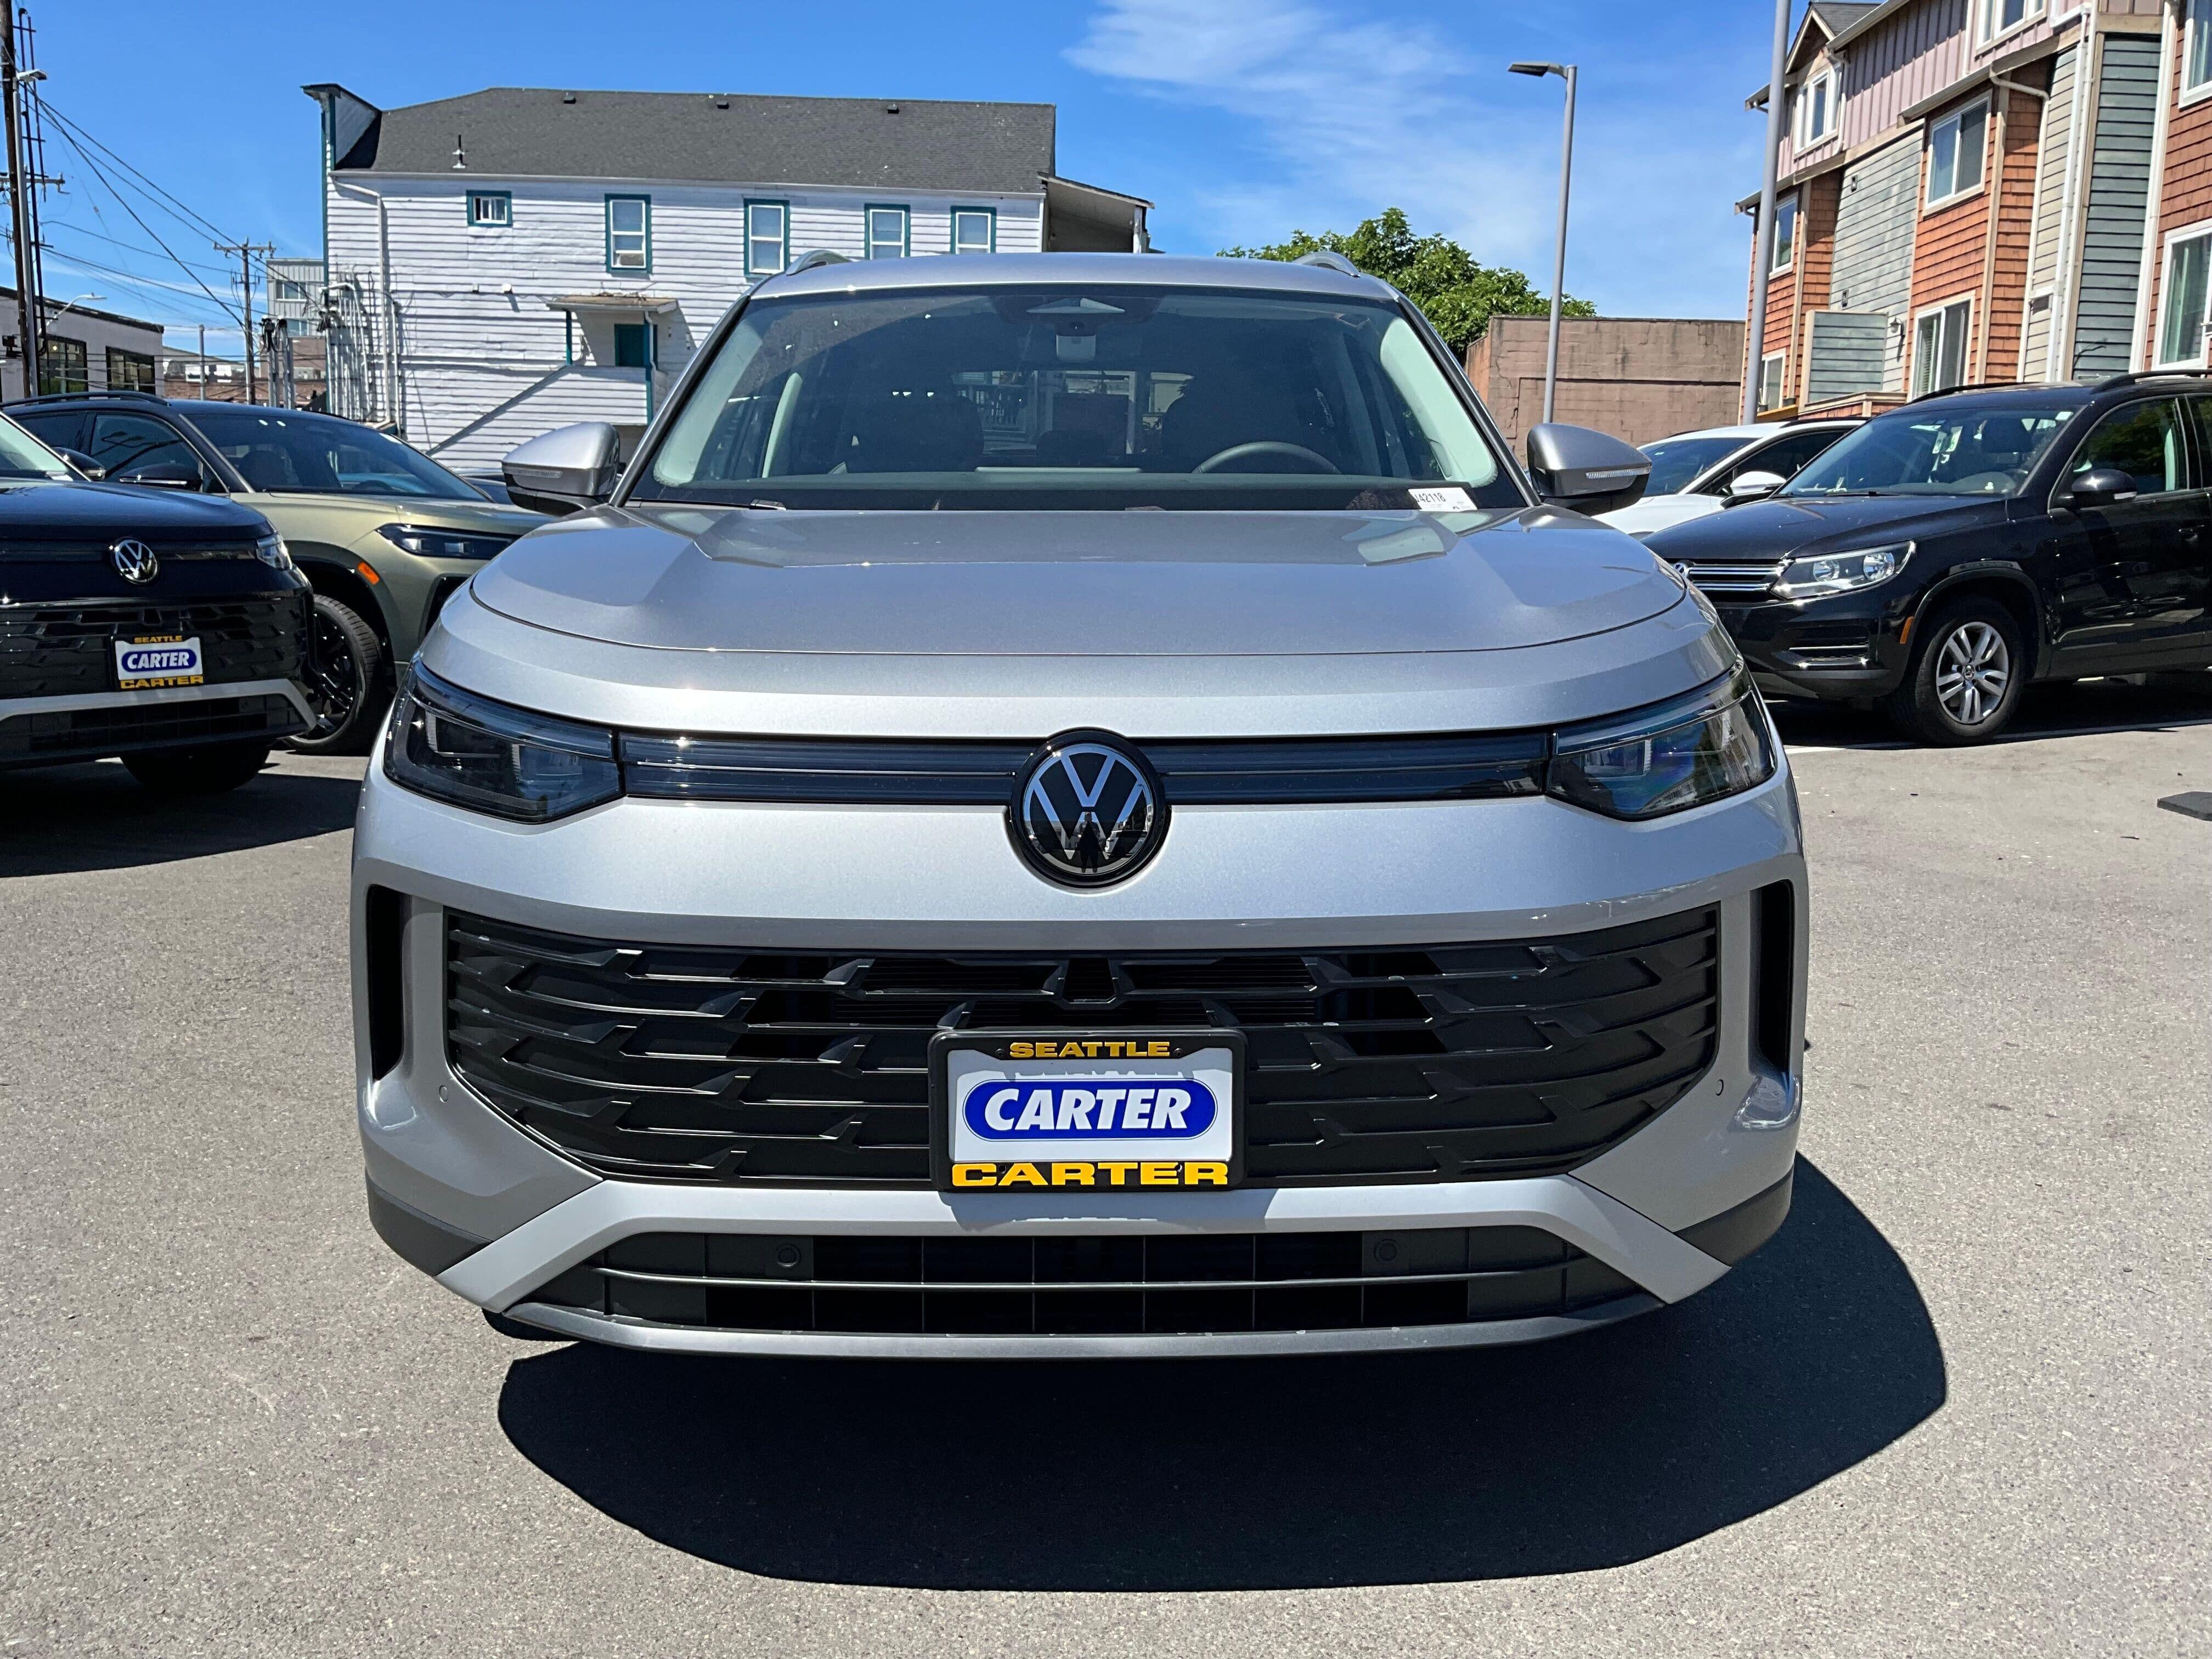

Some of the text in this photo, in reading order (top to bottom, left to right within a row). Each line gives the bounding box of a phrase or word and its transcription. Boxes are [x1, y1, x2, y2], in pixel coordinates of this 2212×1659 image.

[134, 635, 183, 644] SEATTLE
[127, 651, 190, 670] CARTER
[120, 675, 204, 690] CARTER
[1028, 747, 1148, 862] VW
[1009, 1041, 1171, 1058] SEATTLE
[984, 1088, 1192, 1131] CARTER
[951, 1162, 1228, 1187] CARTER
